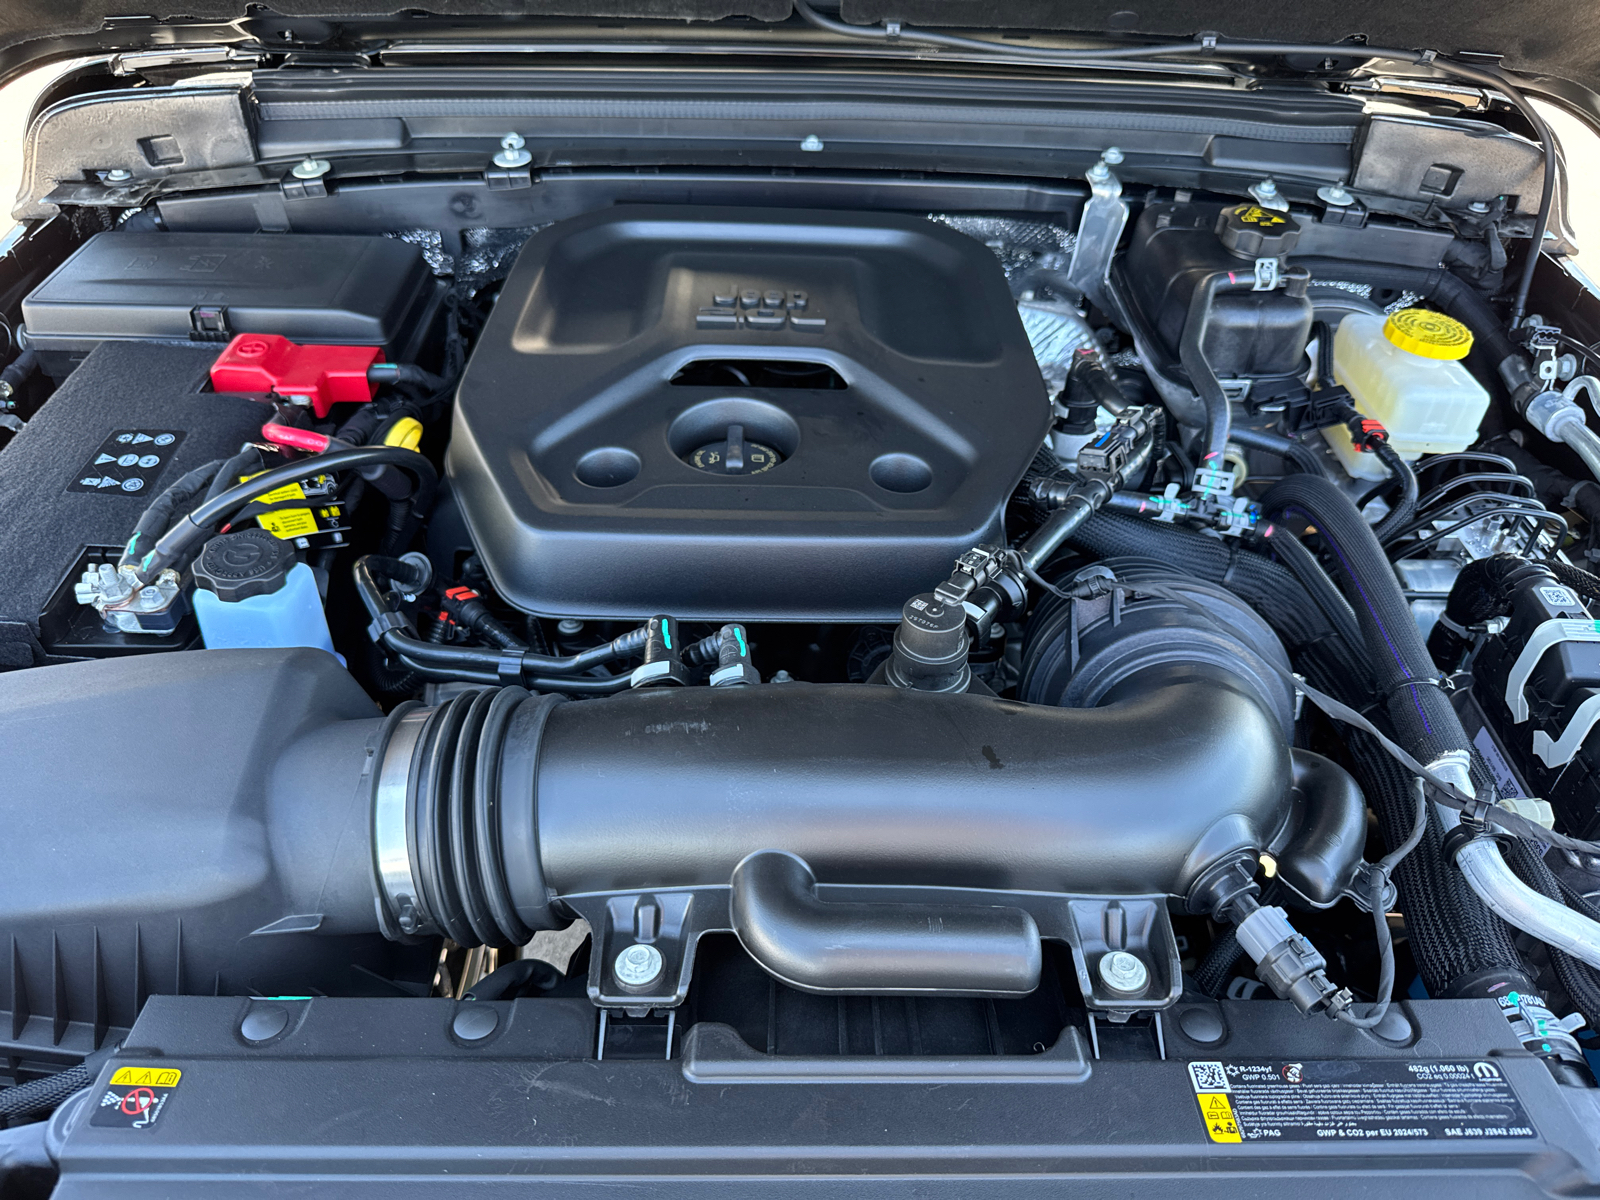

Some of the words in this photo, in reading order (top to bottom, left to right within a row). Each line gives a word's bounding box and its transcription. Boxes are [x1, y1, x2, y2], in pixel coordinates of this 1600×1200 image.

[1239, 1065, 1273, 1074] R-1234yf
[1408, 1065, 1430, 1074] 482g
[1457, 1065, 1470, 1073] lb)
[1316, 1129, 1337, 1137] GWP
[1346, 1128, 1365, 1136] CO2
[1365, 1129, 1379, 1138] per
[1379, 1128, 1393, 1136] EU
[1393, 1127, 1429, 1137] 2024/573
